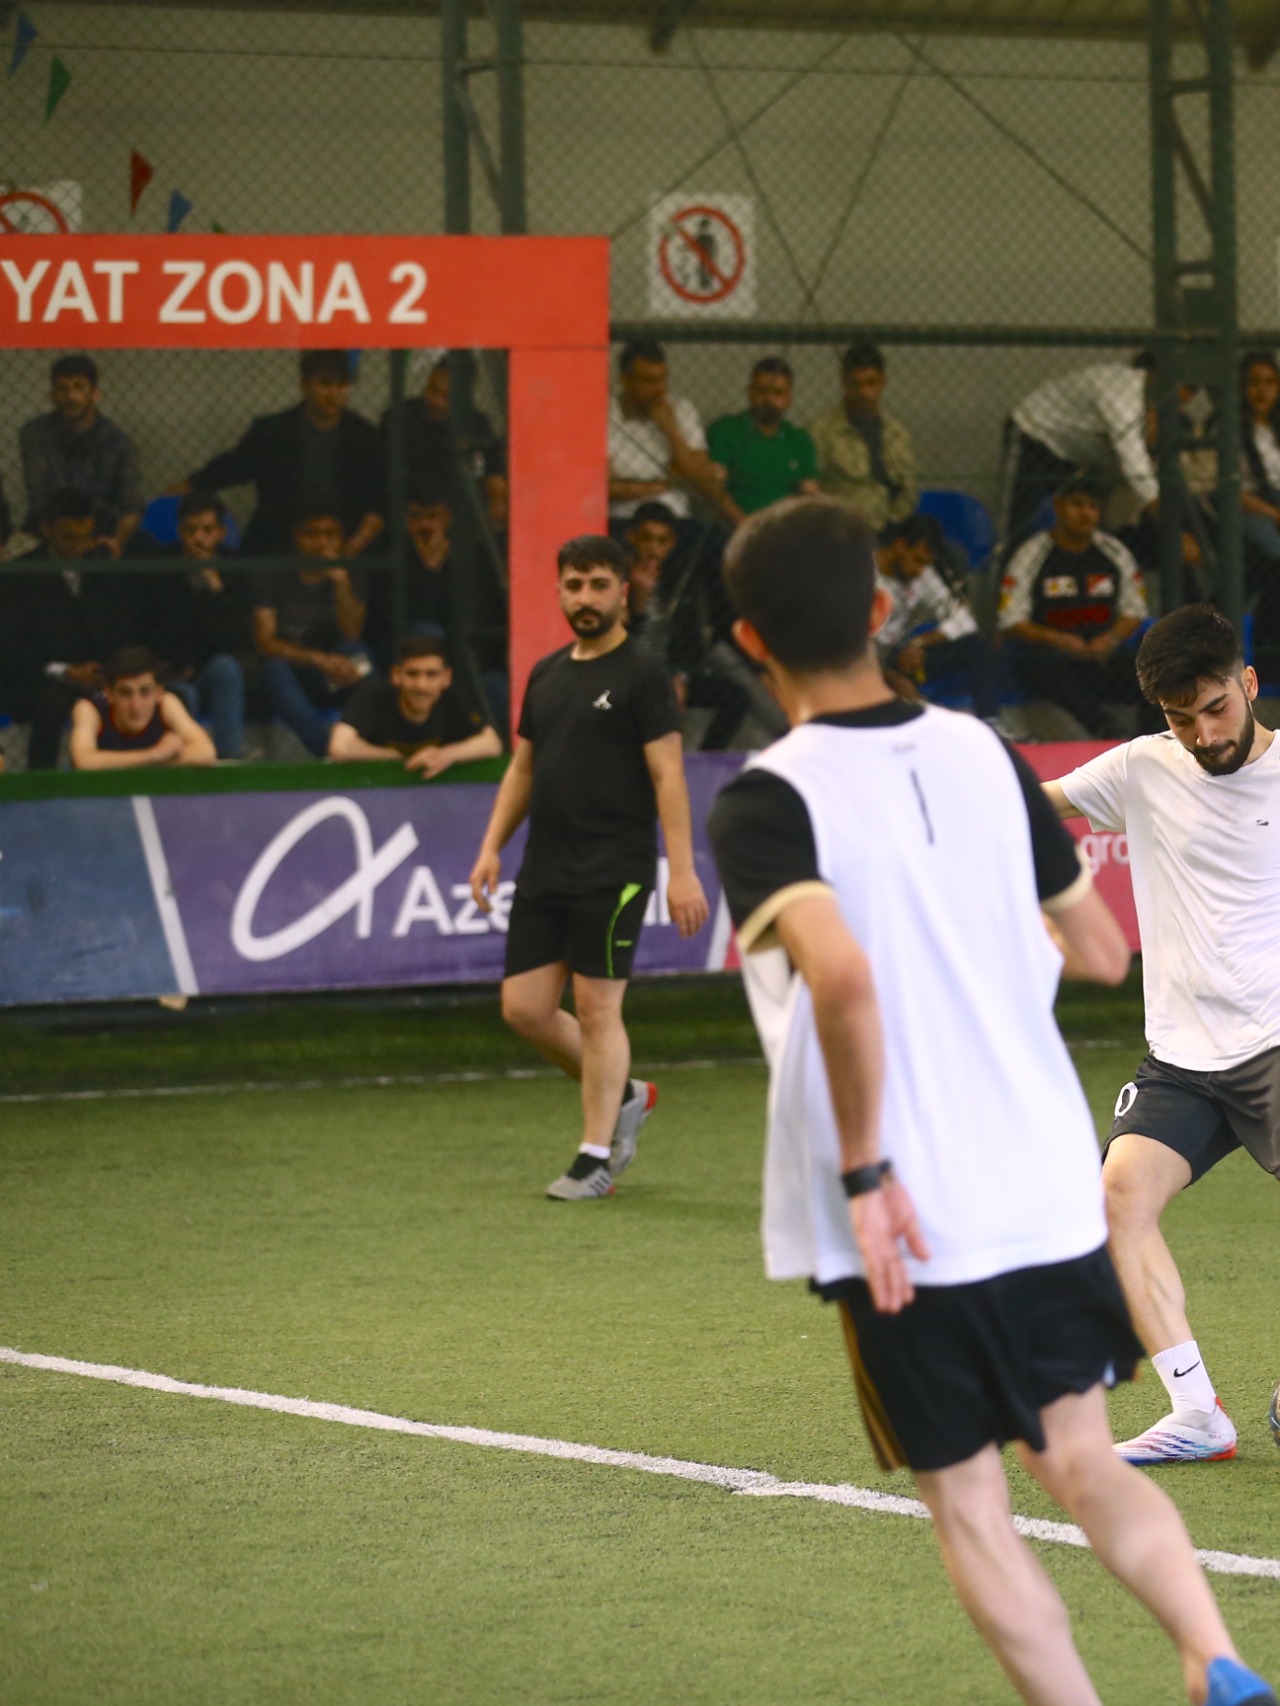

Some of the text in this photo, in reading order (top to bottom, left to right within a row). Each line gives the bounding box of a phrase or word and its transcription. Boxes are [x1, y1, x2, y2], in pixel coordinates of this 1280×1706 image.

[0, 260, 428, 325] YAT ZONA 2
[1078, 833, 1130, 877] gro
